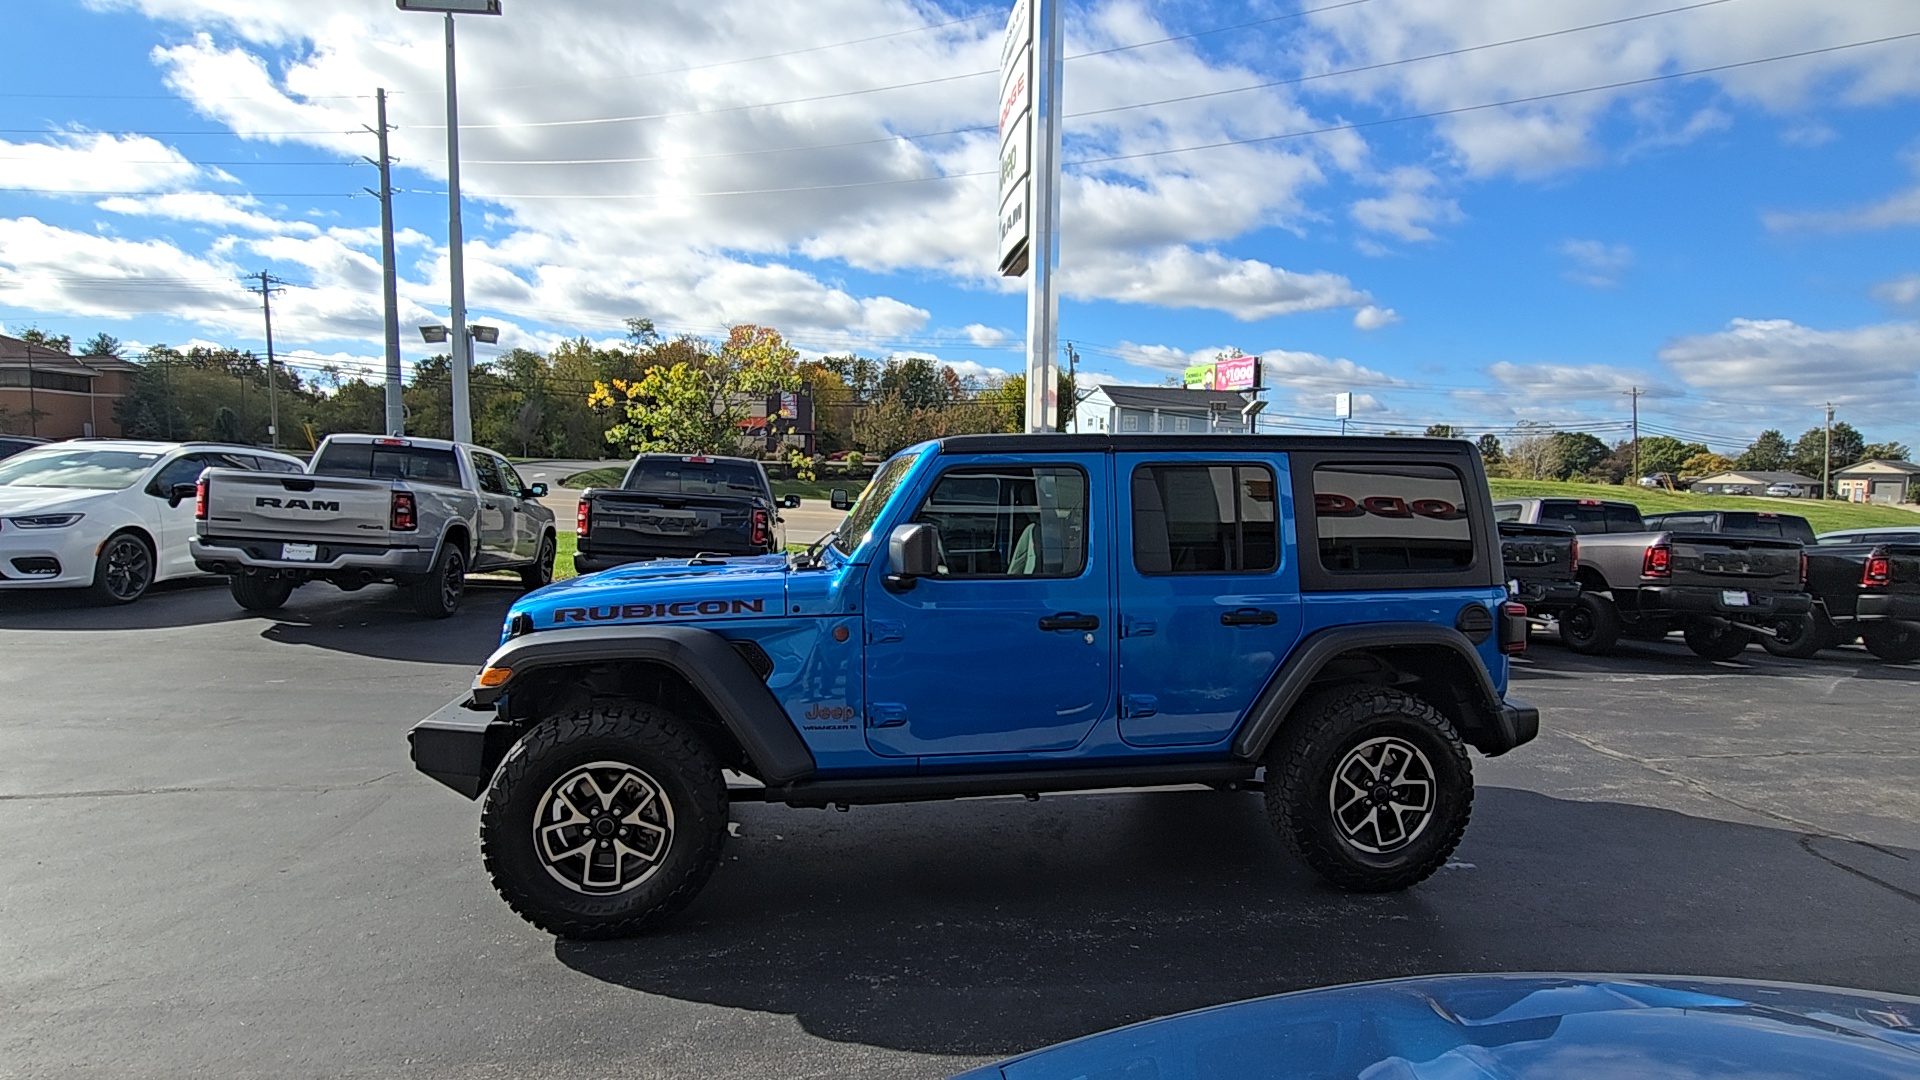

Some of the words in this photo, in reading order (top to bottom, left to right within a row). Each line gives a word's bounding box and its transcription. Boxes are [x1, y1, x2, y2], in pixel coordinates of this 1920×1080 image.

[1002, 202, 1023, 241] RAM
[1226, 365, 1253, 382] $1000
[255, 497, 340, 511] RAM
[554, 599, 763, 623] RUBICON
[805, 703, 855, 722] Jeep
